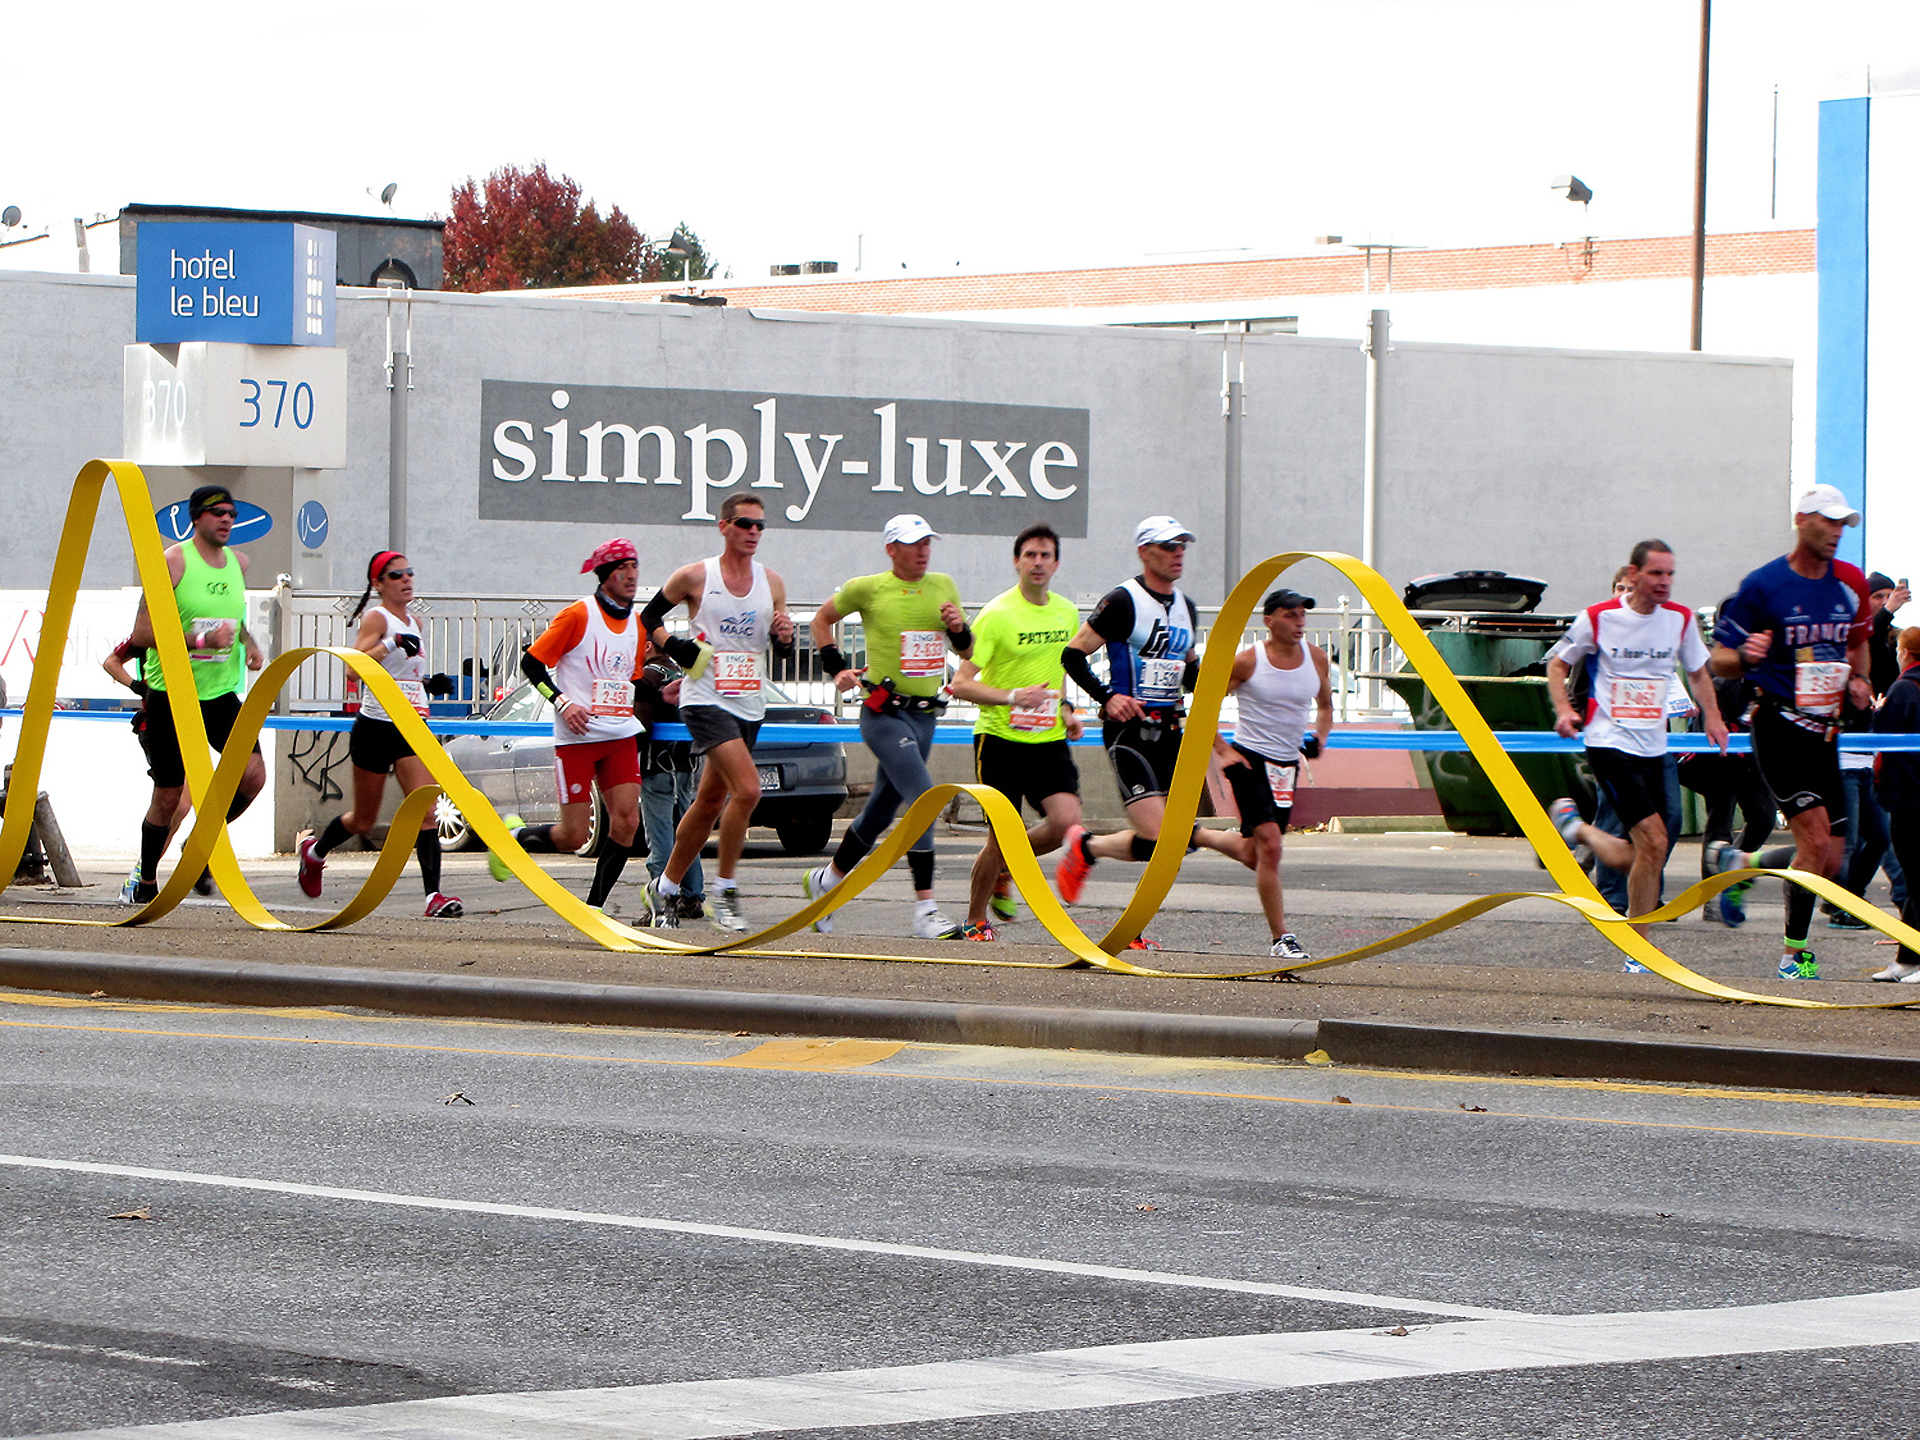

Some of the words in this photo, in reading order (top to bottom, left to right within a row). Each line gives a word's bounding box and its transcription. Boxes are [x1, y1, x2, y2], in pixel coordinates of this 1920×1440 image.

[170, 248, 236, 280] hotel
[170, 286, 194, 316] le
[202, 286, 260, 317] bleu
[143, 379, 187, 430] 370
[239, 378, 315, 430] 370
[491, 388, 1079, 523] simply-luxe
[719, 624, 755, 637] MAAC
[1784, 623, 1850, 646] FRANCE
[726, 655, 746, 663] ING
[603, 682, 621, 691] ING
